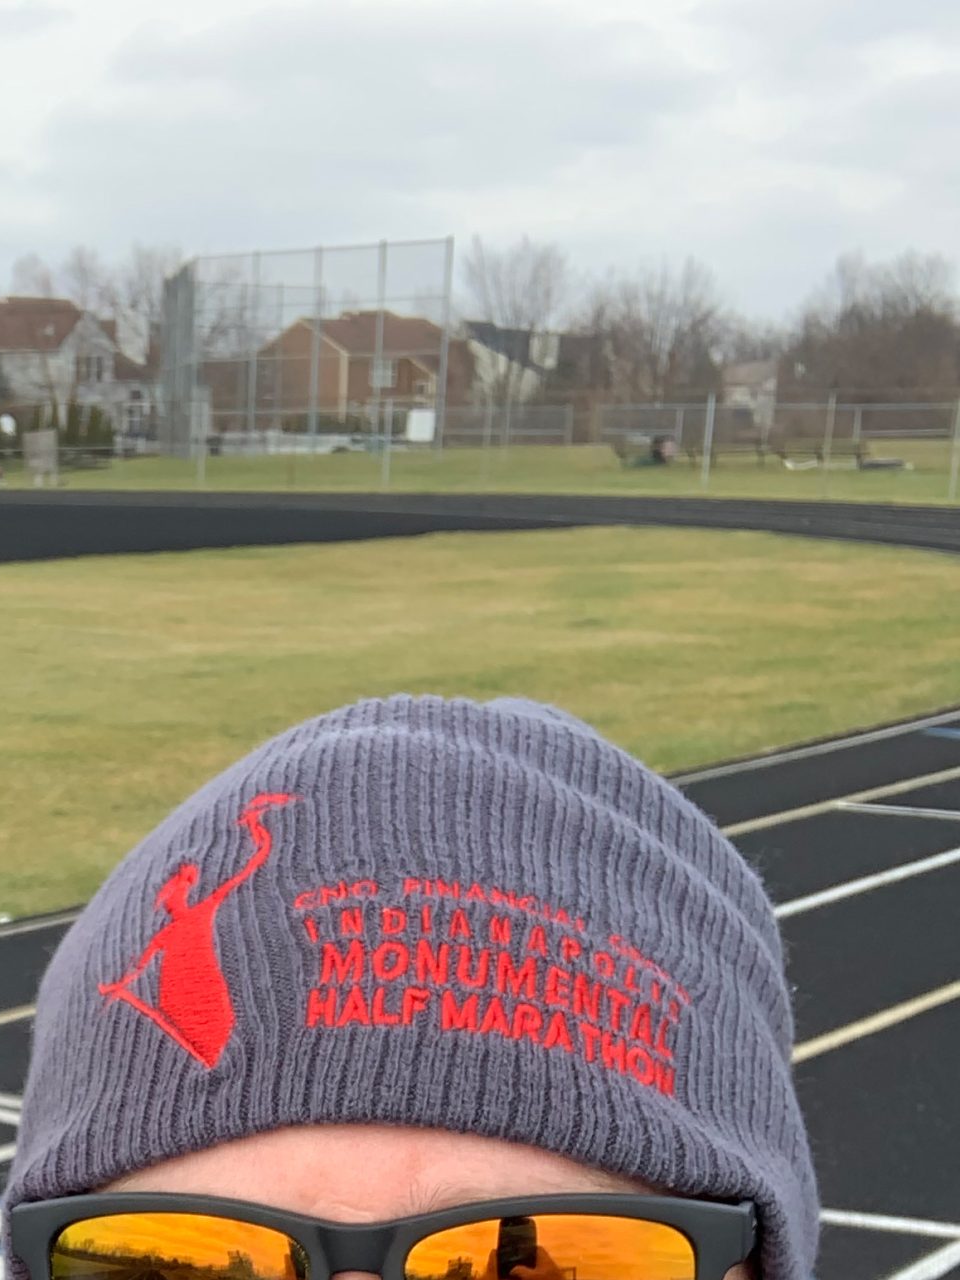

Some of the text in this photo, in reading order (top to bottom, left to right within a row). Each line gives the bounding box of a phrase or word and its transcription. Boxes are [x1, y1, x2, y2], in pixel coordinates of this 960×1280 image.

[304, 904, 681, 1024] INDIANAPOLIS
[319, 939, 673, 1059] MONUMENTAL
[306, 985, 676, 1098] HALF MARATHON
